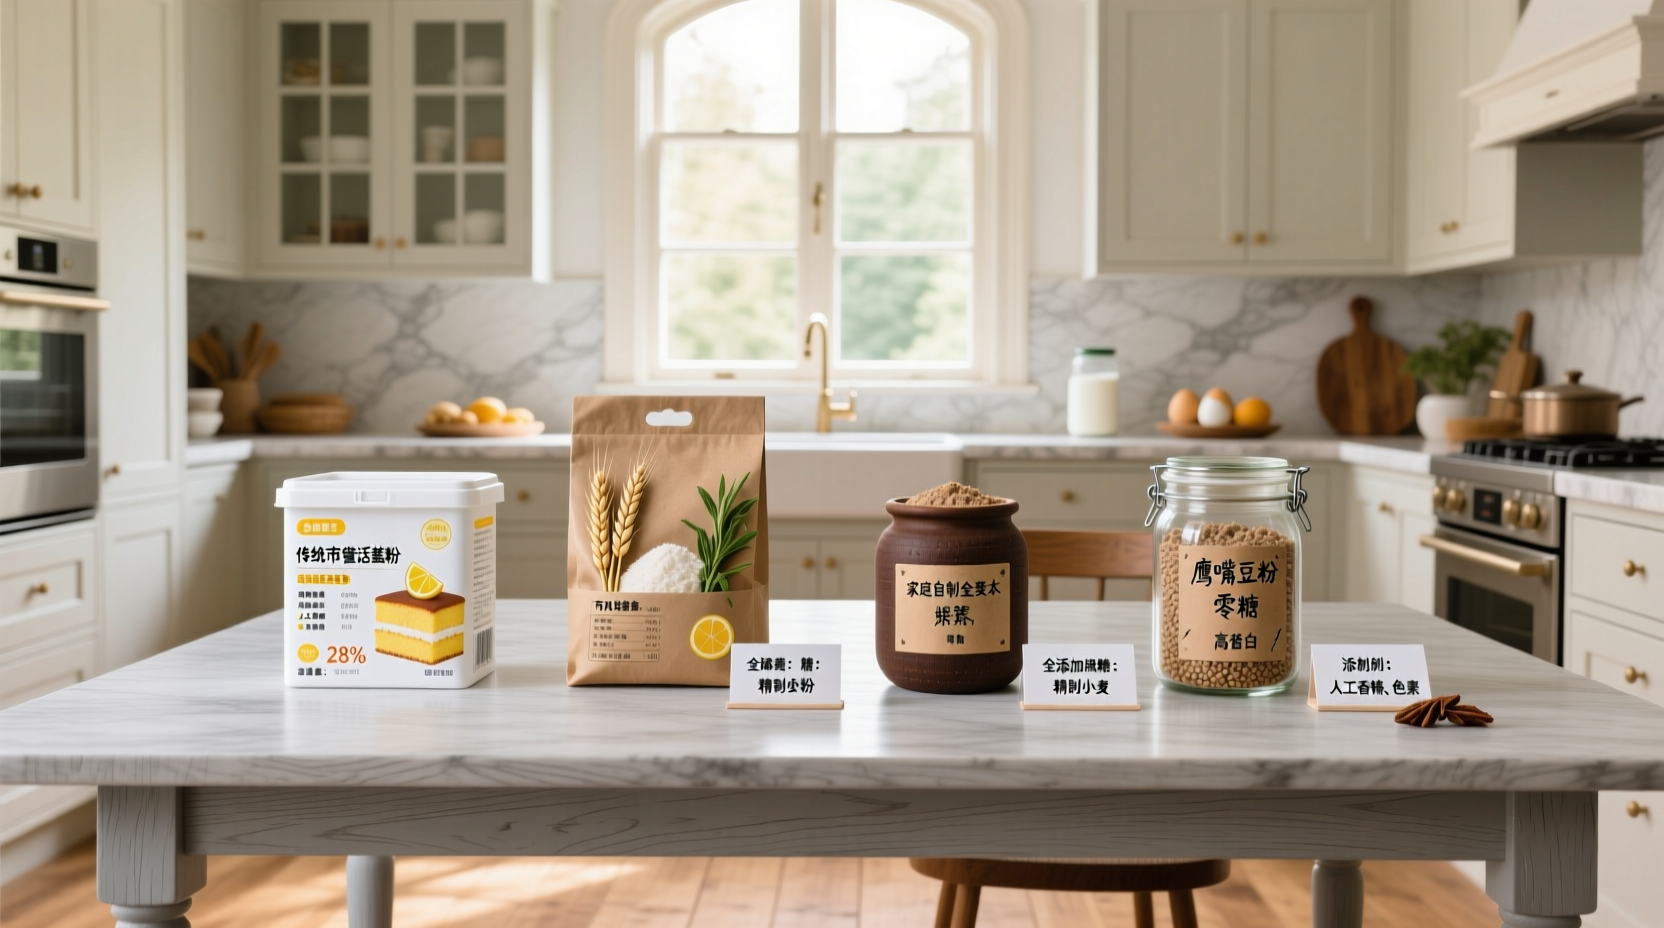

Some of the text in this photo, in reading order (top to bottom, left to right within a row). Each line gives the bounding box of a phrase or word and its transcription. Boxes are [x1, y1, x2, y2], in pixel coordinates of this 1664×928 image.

[1191, 558, 1278, 587] 鹰嘴豆粉
[1214, 593, 1259, 620] 零糖
[326, 646, 366, 663] 28%
